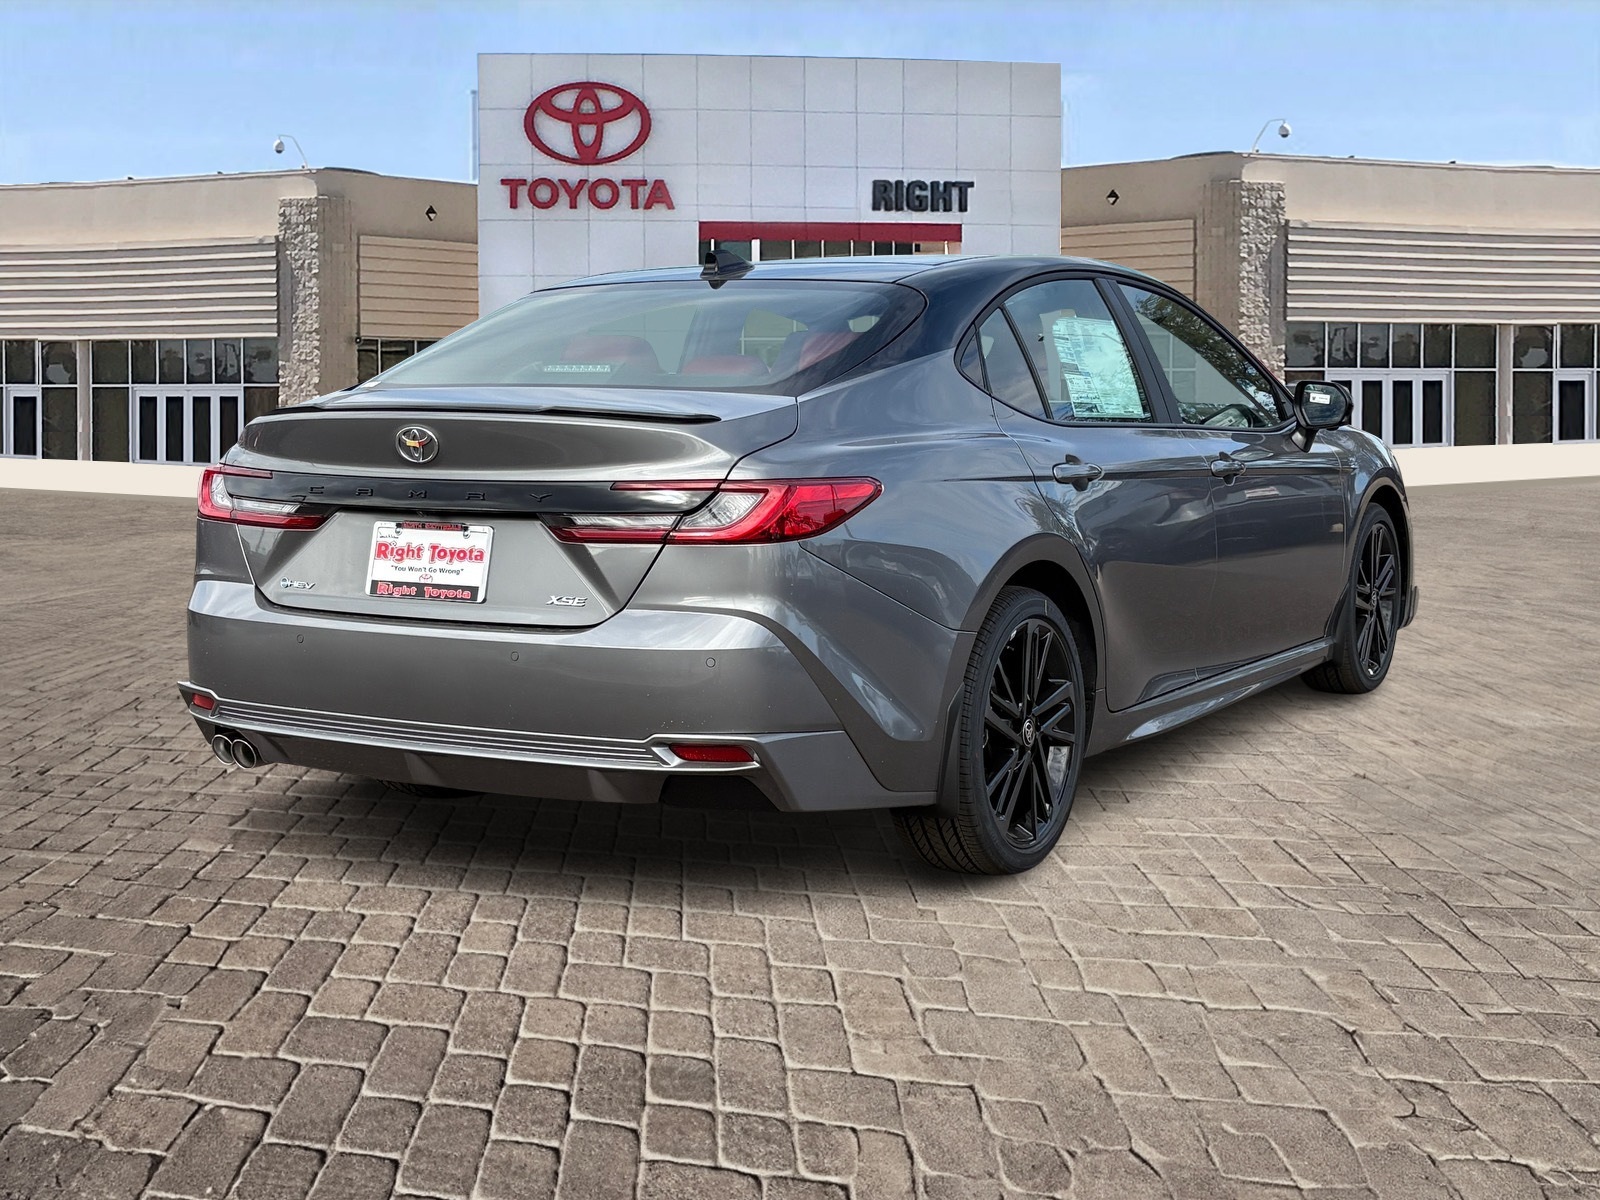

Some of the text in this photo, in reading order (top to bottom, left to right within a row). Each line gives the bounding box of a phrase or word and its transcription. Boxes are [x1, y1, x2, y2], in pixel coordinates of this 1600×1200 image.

[500, 178, 675, 210] TOYOTA
[872, 180, 974, 212] RIGHT
[308, 486, 552, 502] CAMRY
[375, 541, 485, 565] Right Toyota
[377, 582, 472, 599] Right Toyota
[545, 595, 588, 608] XSE
